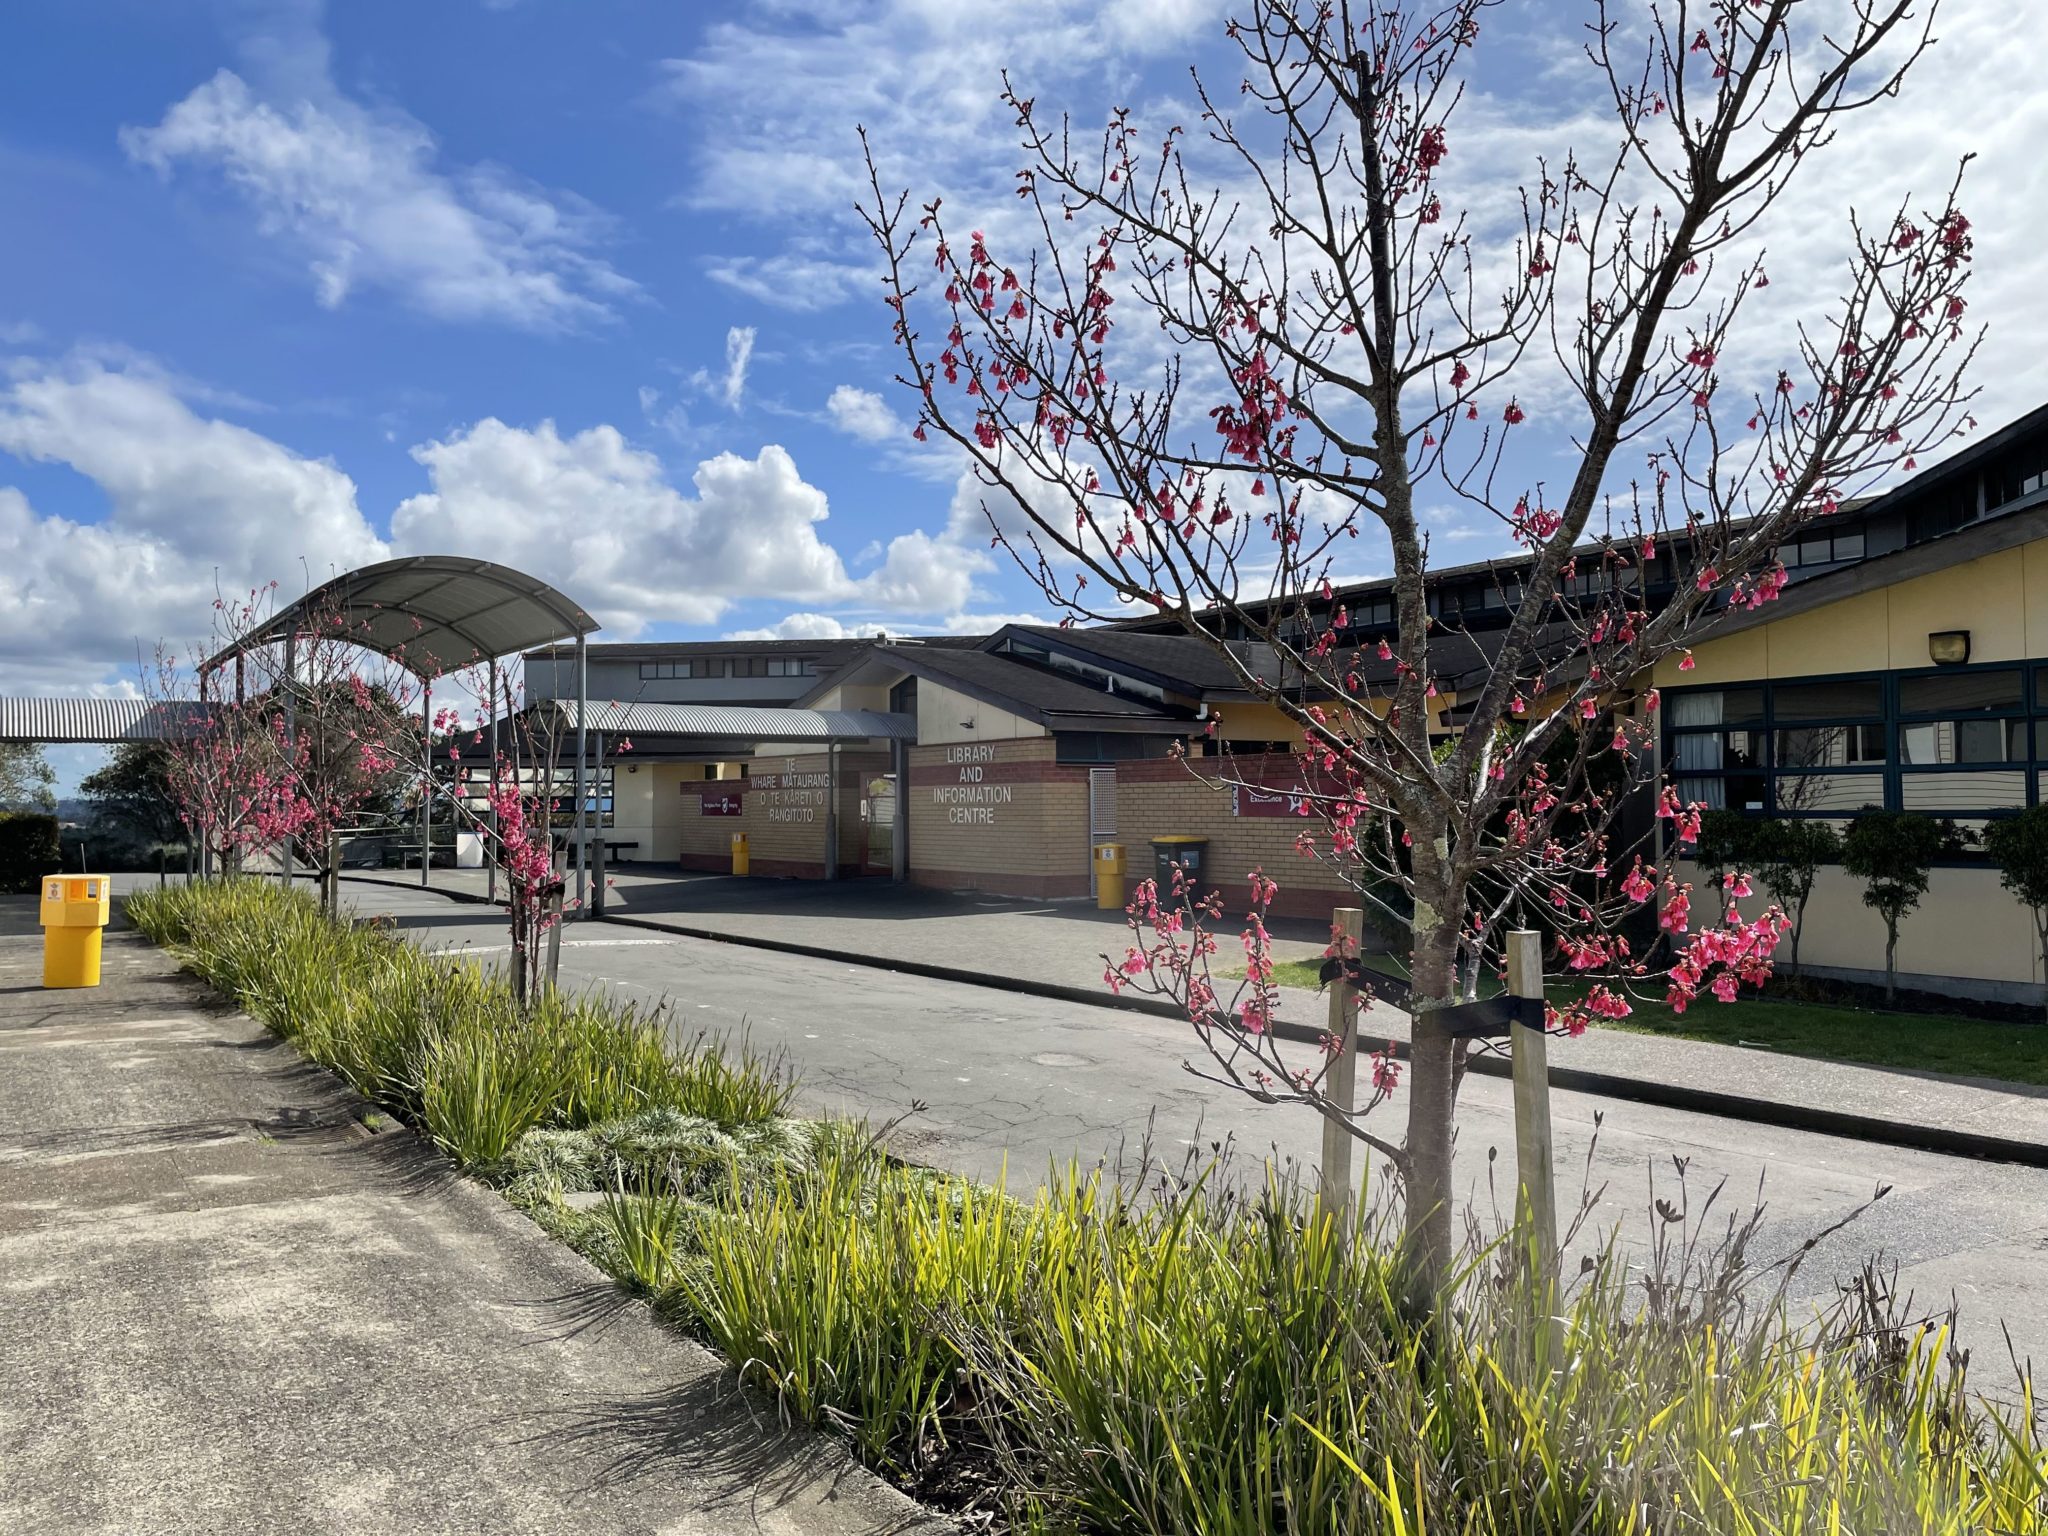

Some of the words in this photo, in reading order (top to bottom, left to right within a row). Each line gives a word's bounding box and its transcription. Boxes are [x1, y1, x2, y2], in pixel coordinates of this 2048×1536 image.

[947, 745, 995, 763] LIBRARY
[785, 758, 796, 772] TE
[751, 775, 776, 789] WHARE
[959, 766, 983, 783] AND
[760, 792, 766, 806] O
[771, 792, 780, 805] TE
[817, 791, 823, 805] O
[933, 786, 1011, 803] INFORMATION
[769, 808, 814, 822] RANGITOTO
[949, 808, 994, 823] CENTRE
